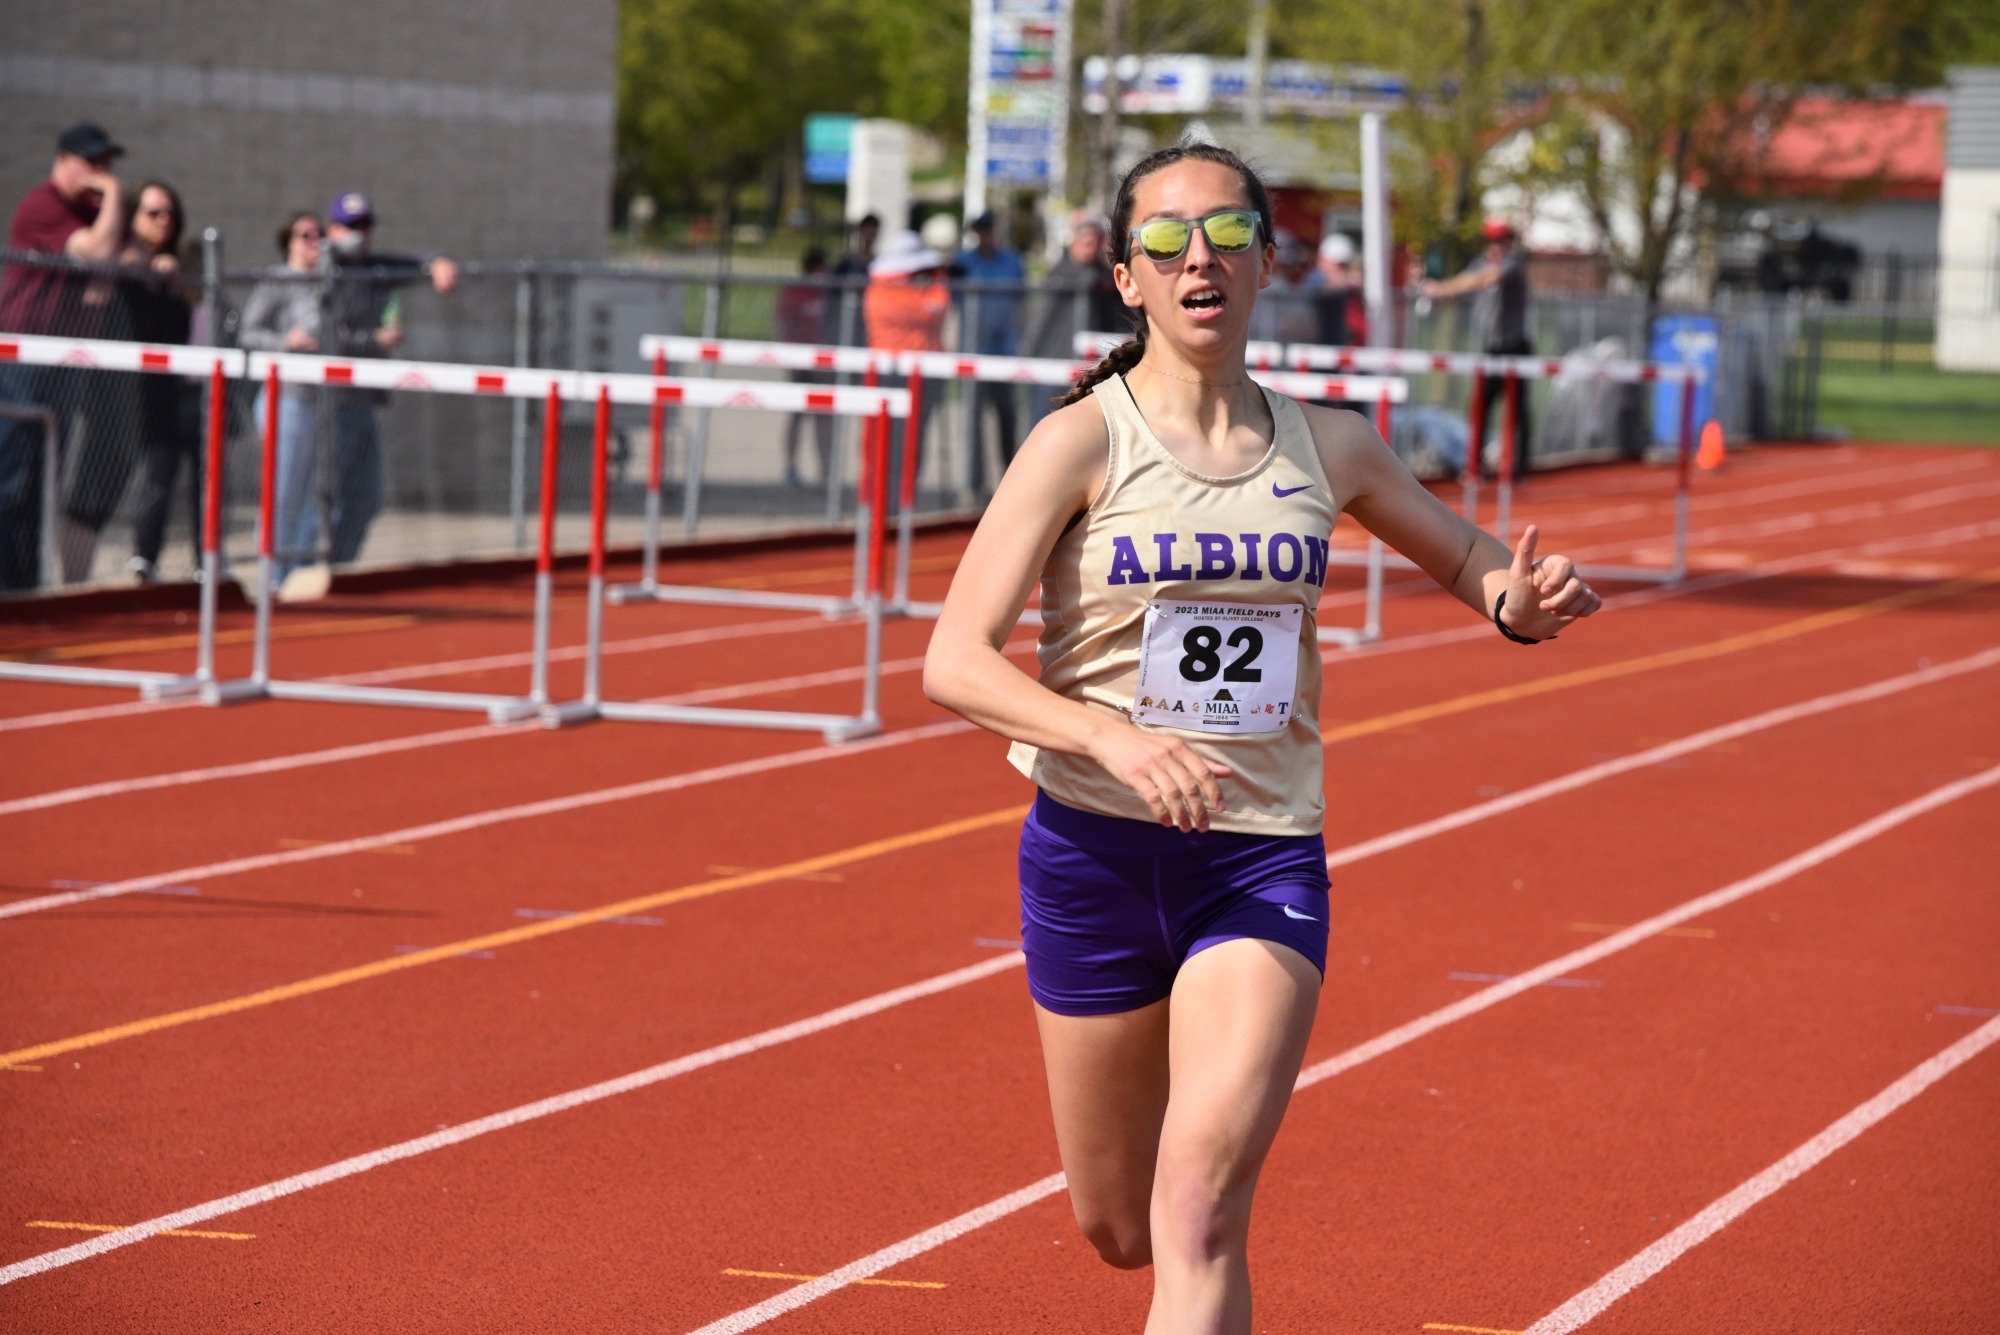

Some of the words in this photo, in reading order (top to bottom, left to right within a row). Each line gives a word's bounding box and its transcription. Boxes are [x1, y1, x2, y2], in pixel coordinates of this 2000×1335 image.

[1106, 532, 1330, 588] ALBION
[1174, 606, 1199, 615] 2023
[1201, 606, 1225, 615] MIAA
[1227, 607, 1255, 616] FIELD
[1256, 610, 1281, 618] DAYS
[1178, 625, 1264, 683] 82
[1205, 702, 1240, 714] MIAA
[1278, 701, 1289, 715] T
